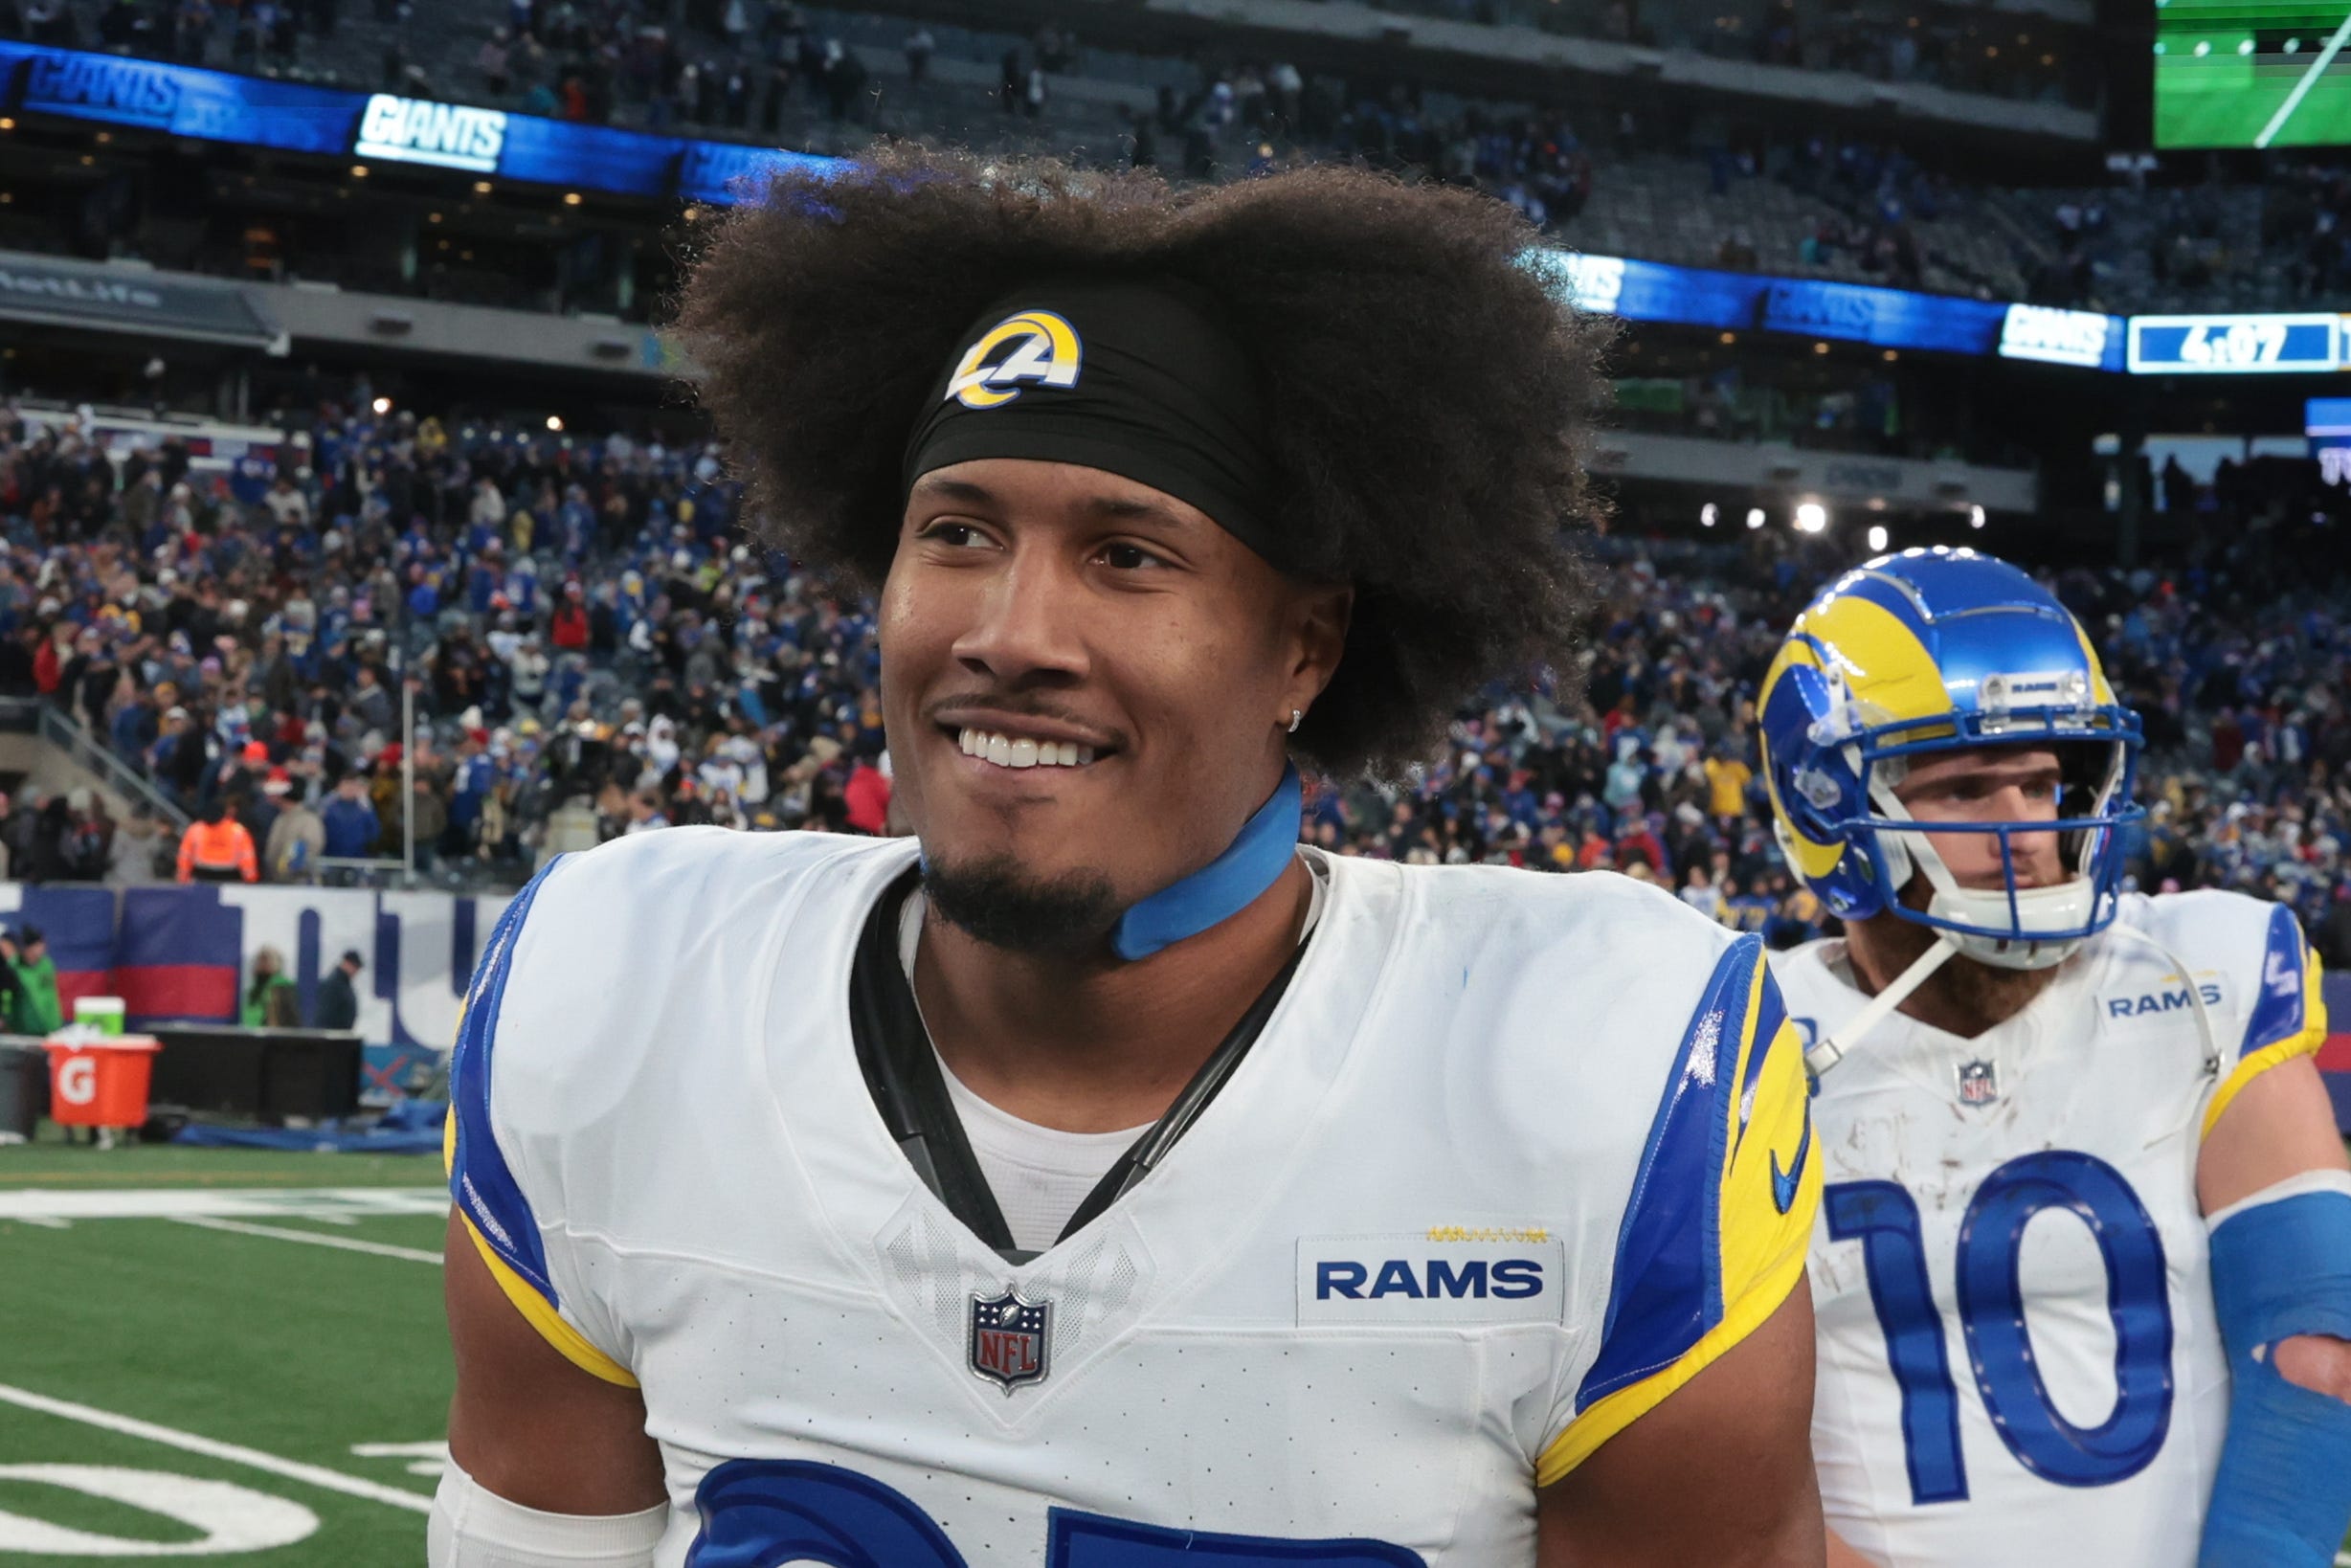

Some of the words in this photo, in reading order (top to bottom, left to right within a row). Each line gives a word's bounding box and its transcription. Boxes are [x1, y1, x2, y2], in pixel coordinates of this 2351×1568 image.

[359, 93, 507, 159] GIANTS
[2108, 984, 2222, 1018] RAMS
[59, 1056, 97, 1105] G
[1316, 1260, 1544, 1300] RAMS
[1824, 1149, 2174, 1507] 10
[979, 1331, 1038, 1376] NFL
